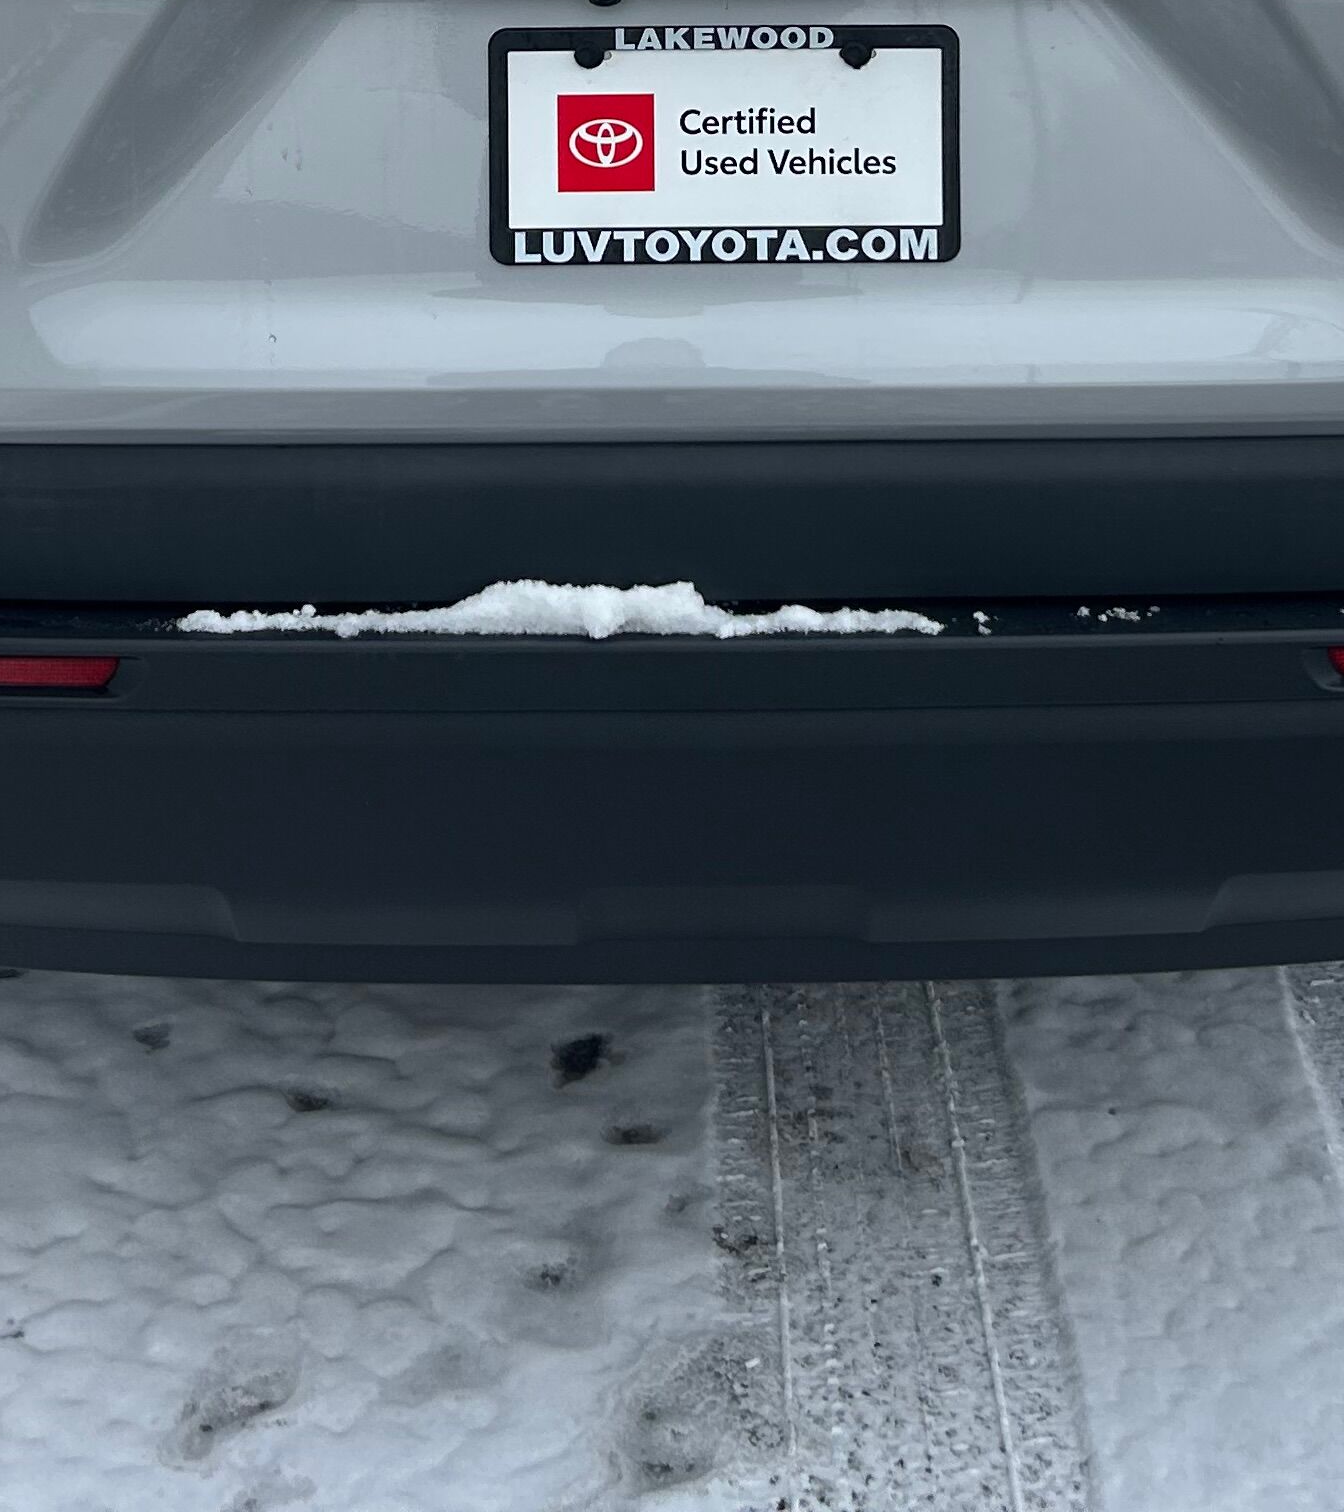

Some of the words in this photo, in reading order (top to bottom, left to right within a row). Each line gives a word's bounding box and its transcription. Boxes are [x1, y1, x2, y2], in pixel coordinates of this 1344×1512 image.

[614, 26, 835, 51] LAKEWOOD
[678, 107, 816, 136] Certified
[680, 148, 758, 176] Used
[766, 147, 898, 176] Vehicles
[513, 227, 940, 264] LUVTOYOTA.COM
